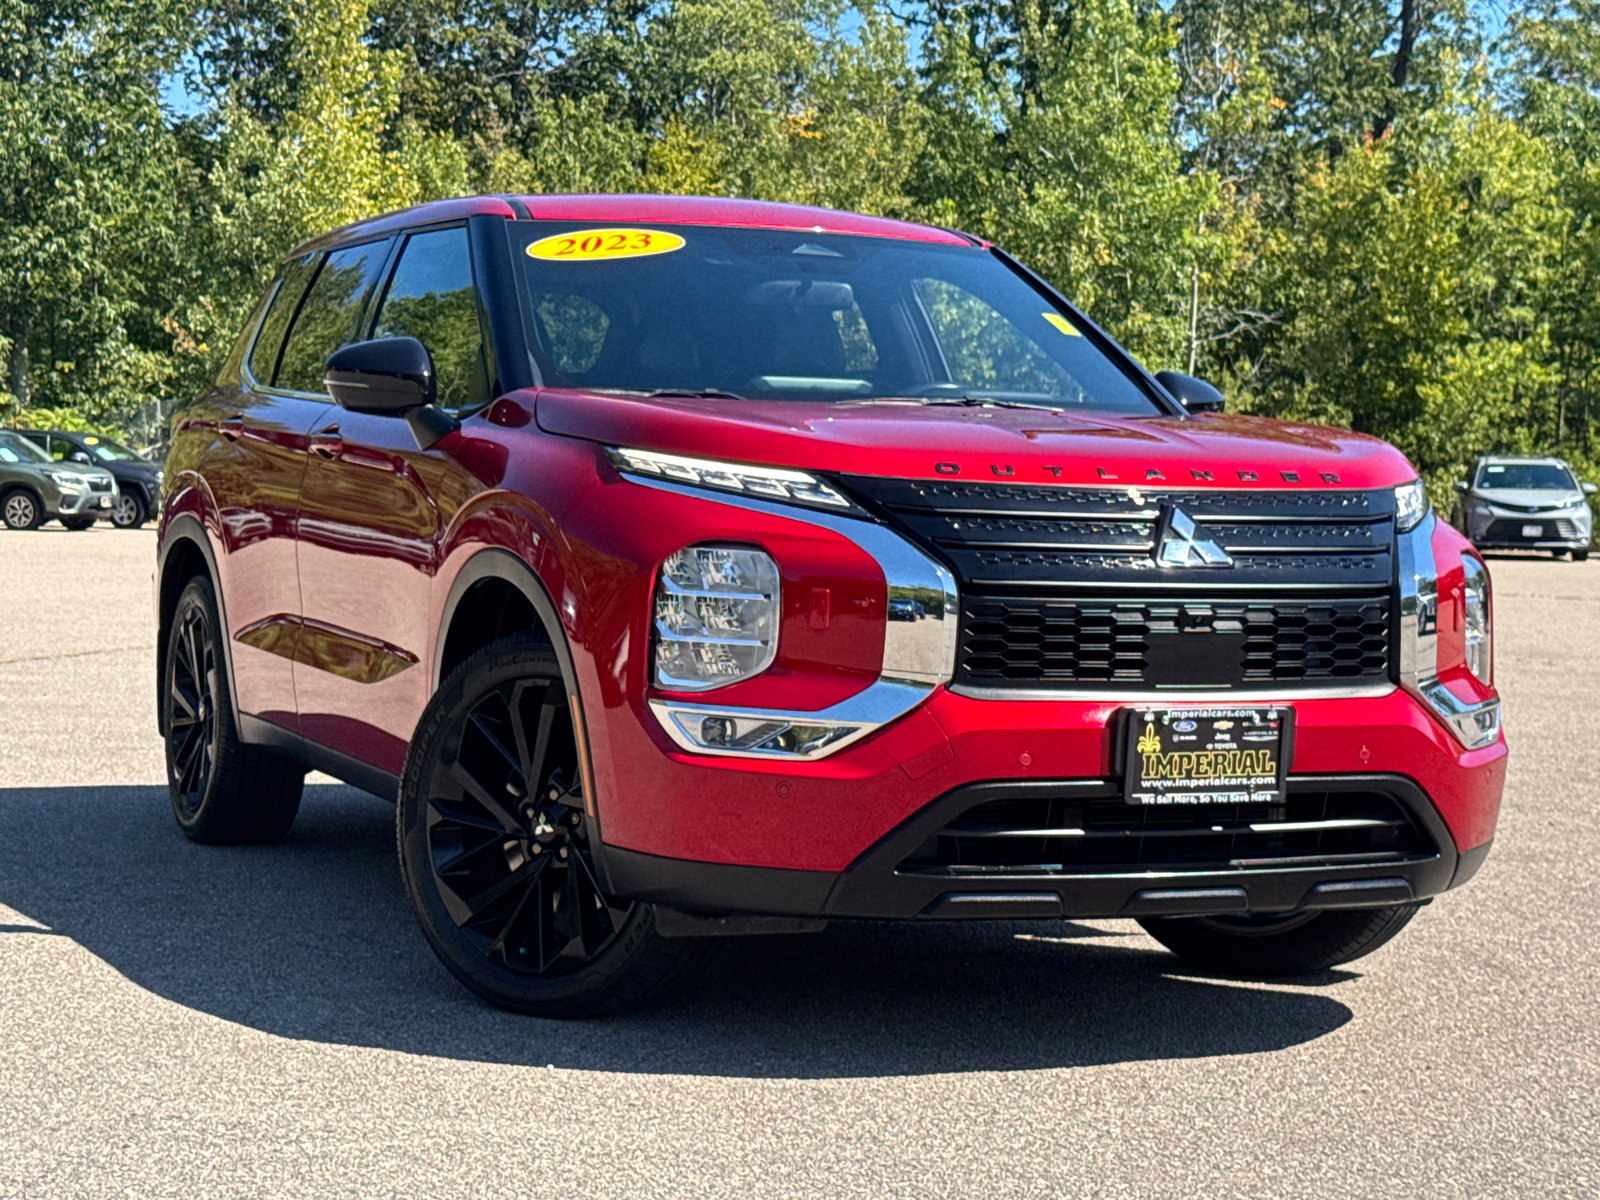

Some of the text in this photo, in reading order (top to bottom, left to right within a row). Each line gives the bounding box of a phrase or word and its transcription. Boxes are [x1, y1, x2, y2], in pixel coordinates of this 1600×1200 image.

[554, 233, 652, 256] 2023
[934, 461, 1343, 484] OUTLANDER
[1214, 742, 1238, 750] TOYOTA
[1141, 750, 1277, 779] IMPERIAL
[1141, 776, 1276, 789] www.imperialcars.com
[1140, 796, 1155, 804] We
[1199, 795, 1211, 803] So
[1212, 794, 1228, 803] You
[1229, 794, 1249, 802] Save
[1250, 793, 1271, 802] More
